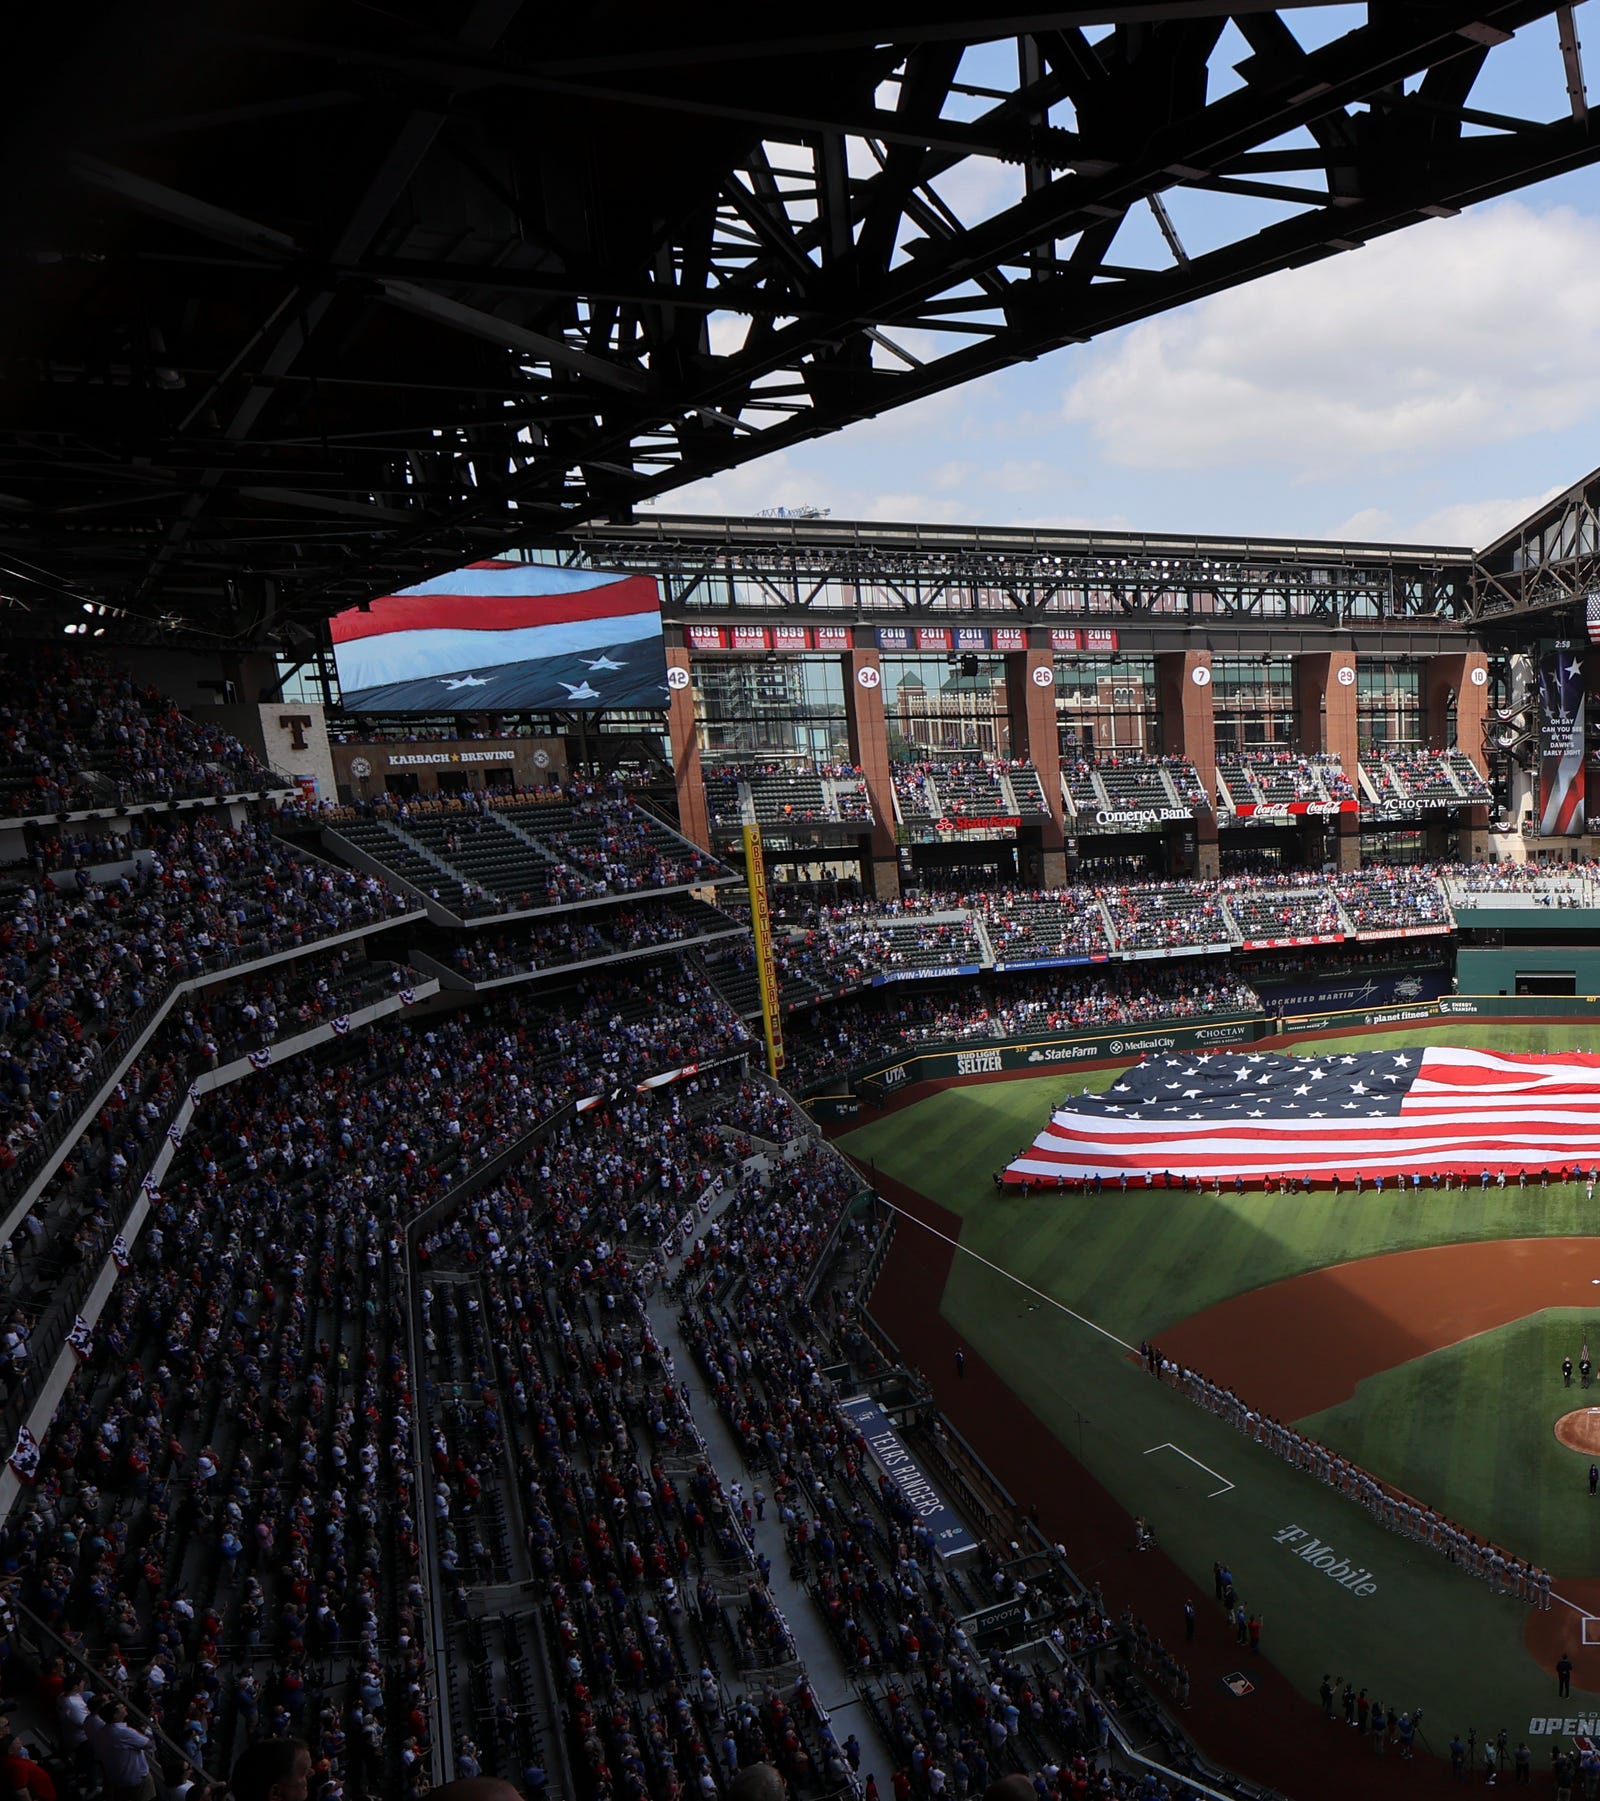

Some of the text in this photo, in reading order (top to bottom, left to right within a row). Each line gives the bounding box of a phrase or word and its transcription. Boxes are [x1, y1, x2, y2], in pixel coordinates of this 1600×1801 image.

[880, 628, 906, 639] 2010
[921, 628, 944, 639] 2011
[959, 628, 982, 639] 2011
[1052, 629, 1075, 639] 2015
[1088, 629, 1111, 640] 2016
[668, 672, 686, 684] 42
[861, 672, 877, 683] 34
[1036, 671, 1050, 682] 26
[1198, 671, 1205, 681] 7
[1340, 671, 1352, 681] 29
[1474, 672, 1483, 681] 10
[279, 714, 312, 750] T
[389, 750, 515, 765] KARBACH BREWING
[1391, 799, 1447, 809] CHOCTAW
[1160, 807, 1193, 820] Bank
[753, 846, 766, 913] BRING
[1358, 930, 1402, 940] WHATABURGER
[1405, 927, 1448, 937] WHATABURGER
[760, 919, 771, 958] THE
[765, 963, 777, 1016] HEAT
[1266, 992, 1355, 1007] LOCKHEED MARTIN
[1373, 1011, 1429, 1025] planet fitness
[1200, 1026, 1245, 1038] CHOCTAW
[1125, 1037, 1175, 1051] Medical City
[957, 1050, 1001, 1060] BUD LIGHT
[957, 1056, 1003, 1076] SELTZER
[885, 1066, 906, 1084] UTA
[869, 1431, 945, 1517] TEXAS RANGERS
[981, 1607, 1021, 1626] TOYOTA
